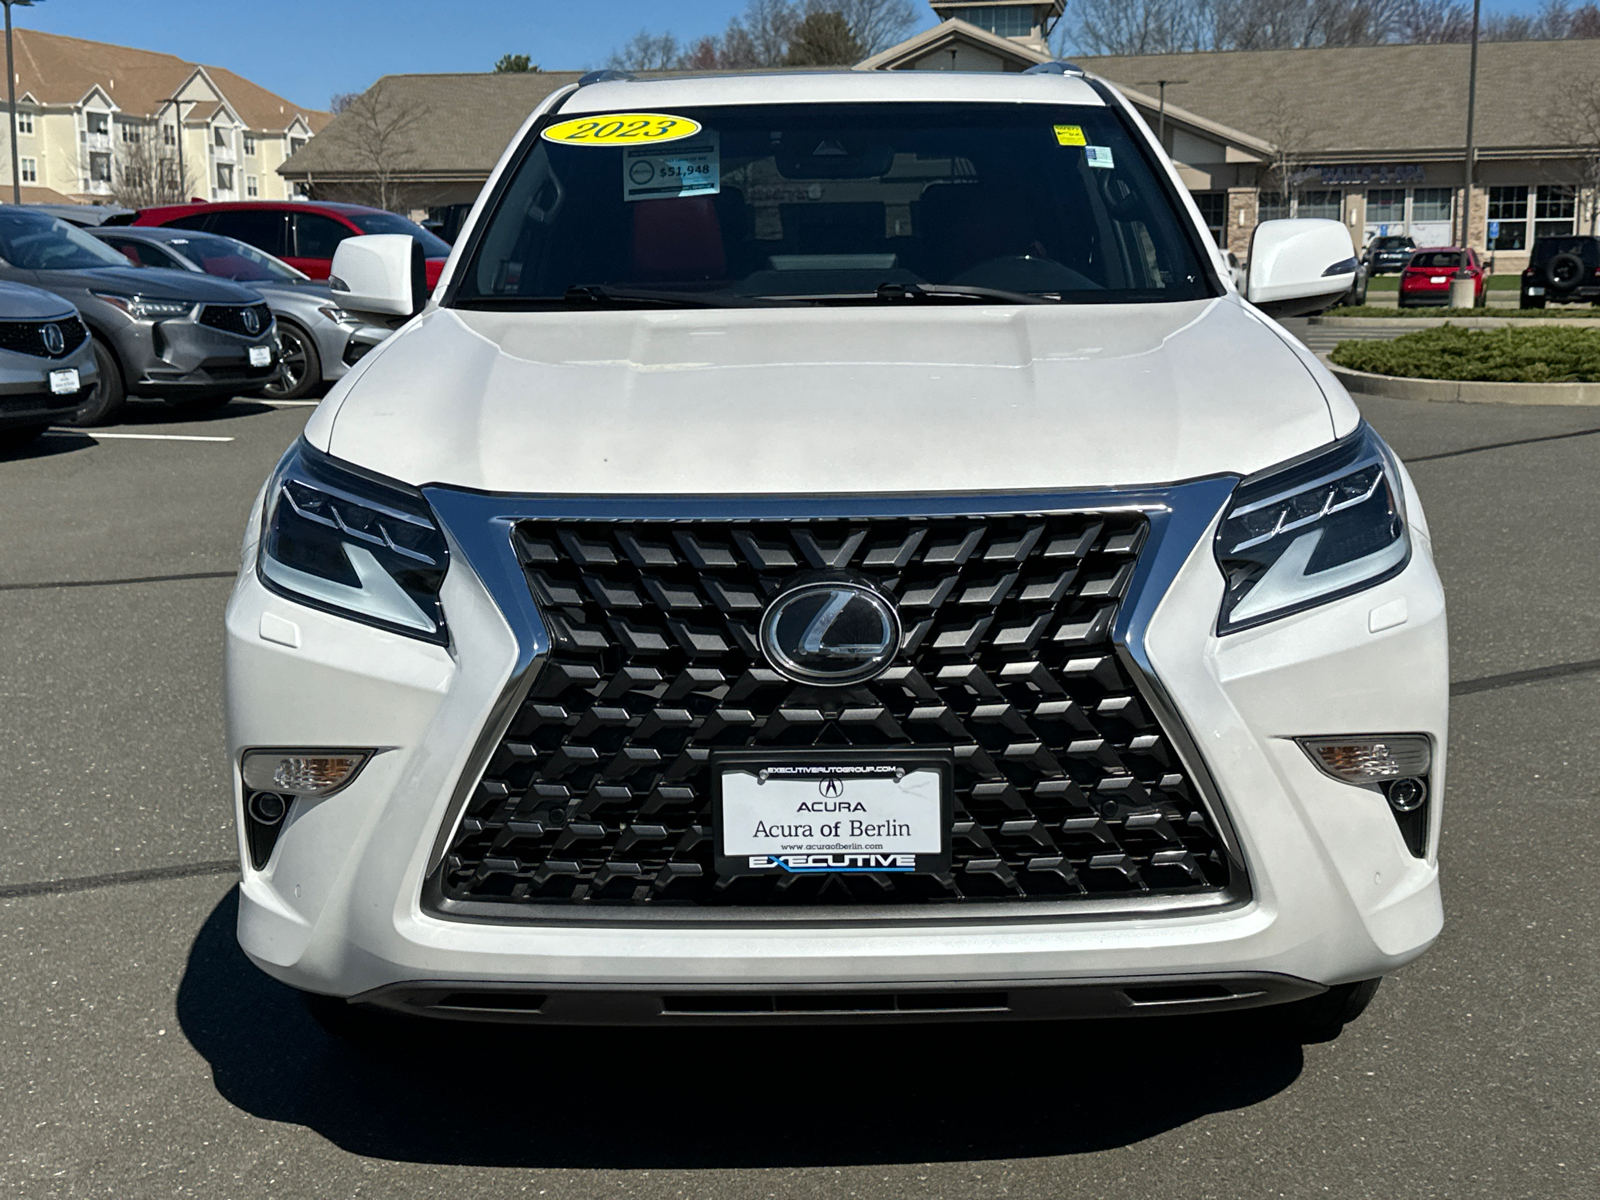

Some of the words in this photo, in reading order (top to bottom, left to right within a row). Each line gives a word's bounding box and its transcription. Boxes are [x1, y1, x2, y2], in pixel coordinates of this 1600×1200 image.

[565, 119, 678, 140] 2023
[660, 164, 710, 178] $51,948
[767, 766, 896, 774] EXECUTIVEAUTOGROUP.COM
[796, 801, 867, 813] ACURA
[753, 820, 814, 838] Acura
[820, 821, 842, 838] of
[849, 819, 912, 837] Berlin
[781, 842, 884, 851] www.acuraofberlin.com
[749, 854, 916, 871] EXECUTIVE
